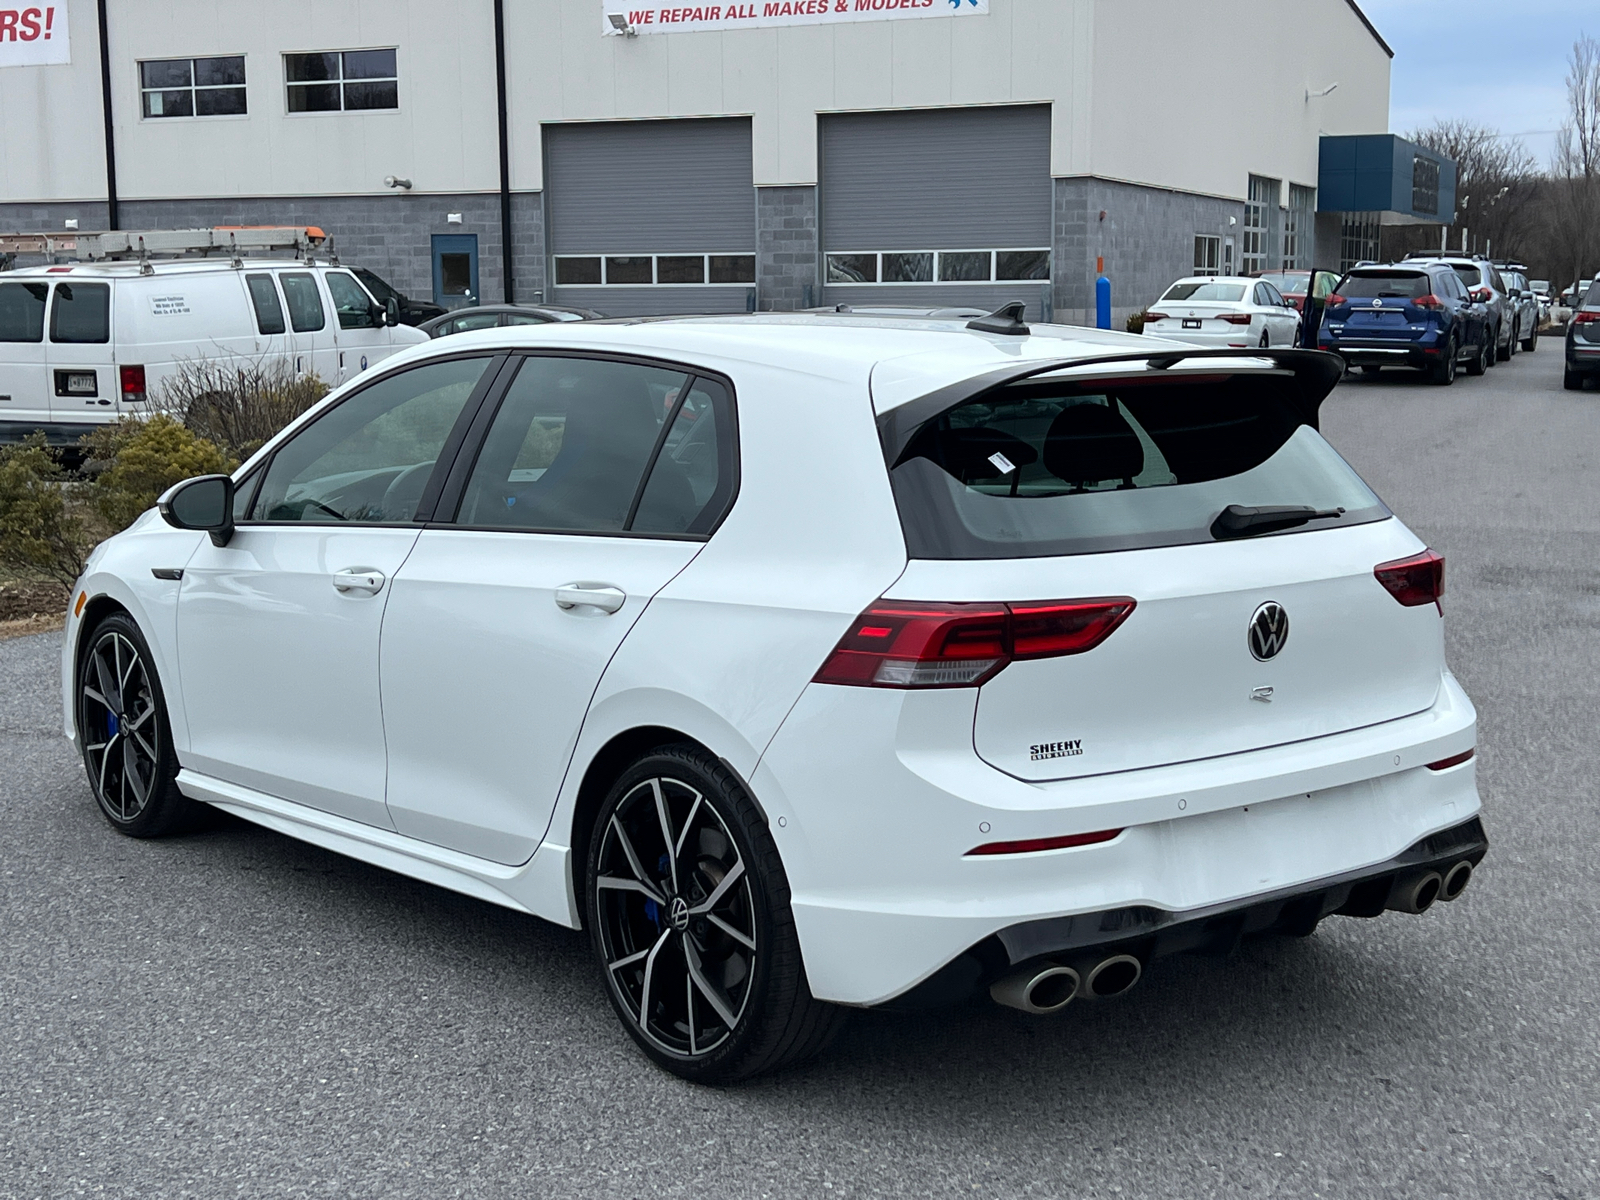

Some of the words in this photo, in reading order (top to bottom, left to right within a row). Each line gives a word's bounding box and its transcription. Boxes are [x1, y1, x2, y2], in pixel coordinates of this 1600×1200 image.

[0, 7, 55, 42] RS!
[629, 10, 655, 25] WE
[659, 6, 722, 23] REPAIR
[724, 4, 757, 19] ALL
[763, 0, 829, 17] MAKES
[834, 0, 849, 13] &
[854, 0, 934, 11] MODELS
[1030, 739, 1082, 755] SHEEHY
